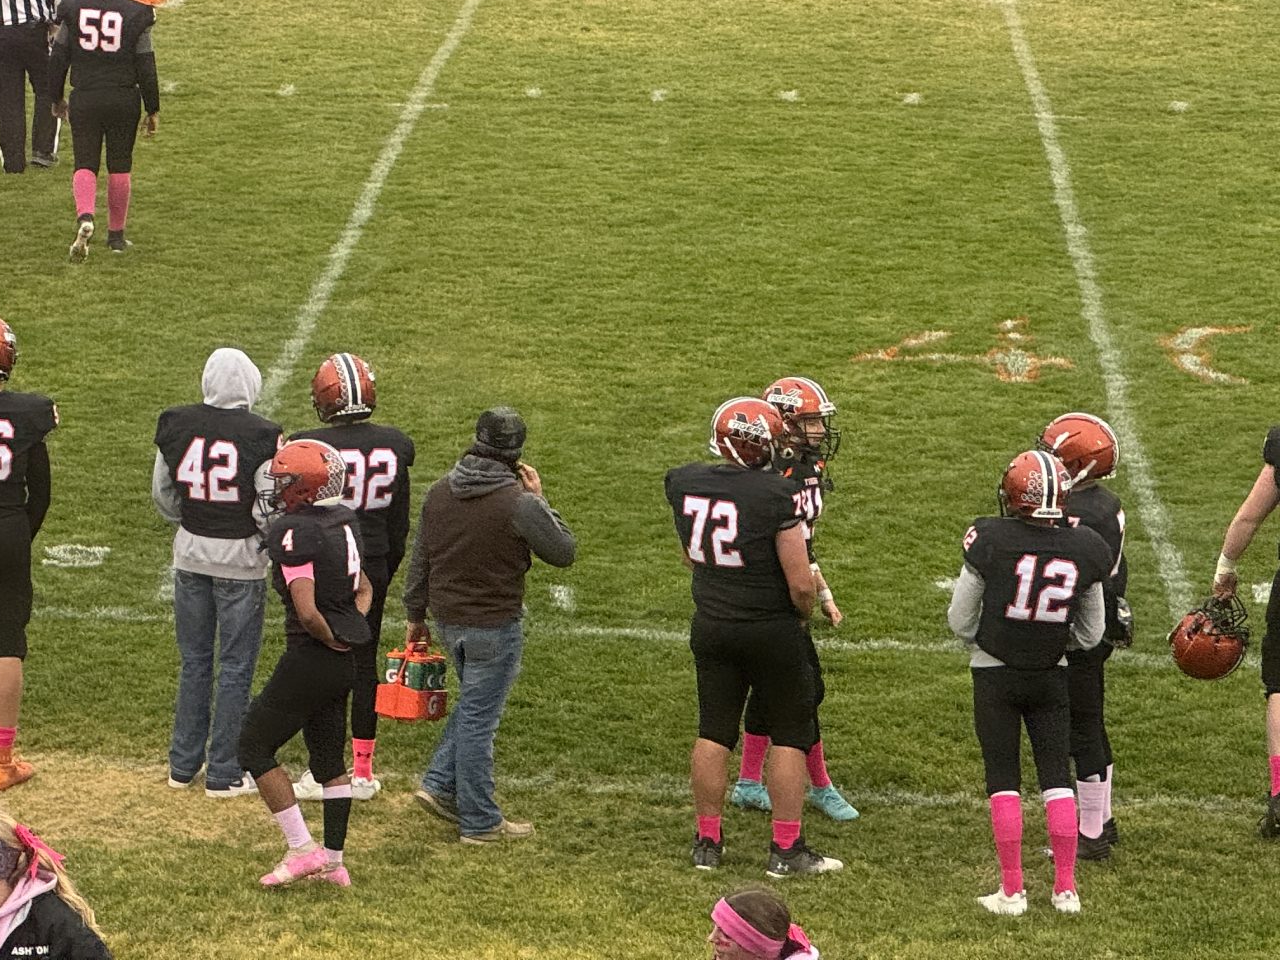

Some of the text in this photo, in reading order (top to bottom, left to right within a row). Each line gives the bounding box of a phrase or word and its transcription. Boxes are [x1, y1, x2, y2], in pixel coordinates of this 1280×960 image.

[78, 8, 123, 52] 59
[731, 420, 766, 437] TIGERS
[176, 437, 240, 503] 42
[281, 528, 294, 552] 4
[682, 495, 745, 567] 72
[1005, 554, 1079, 623] 12
